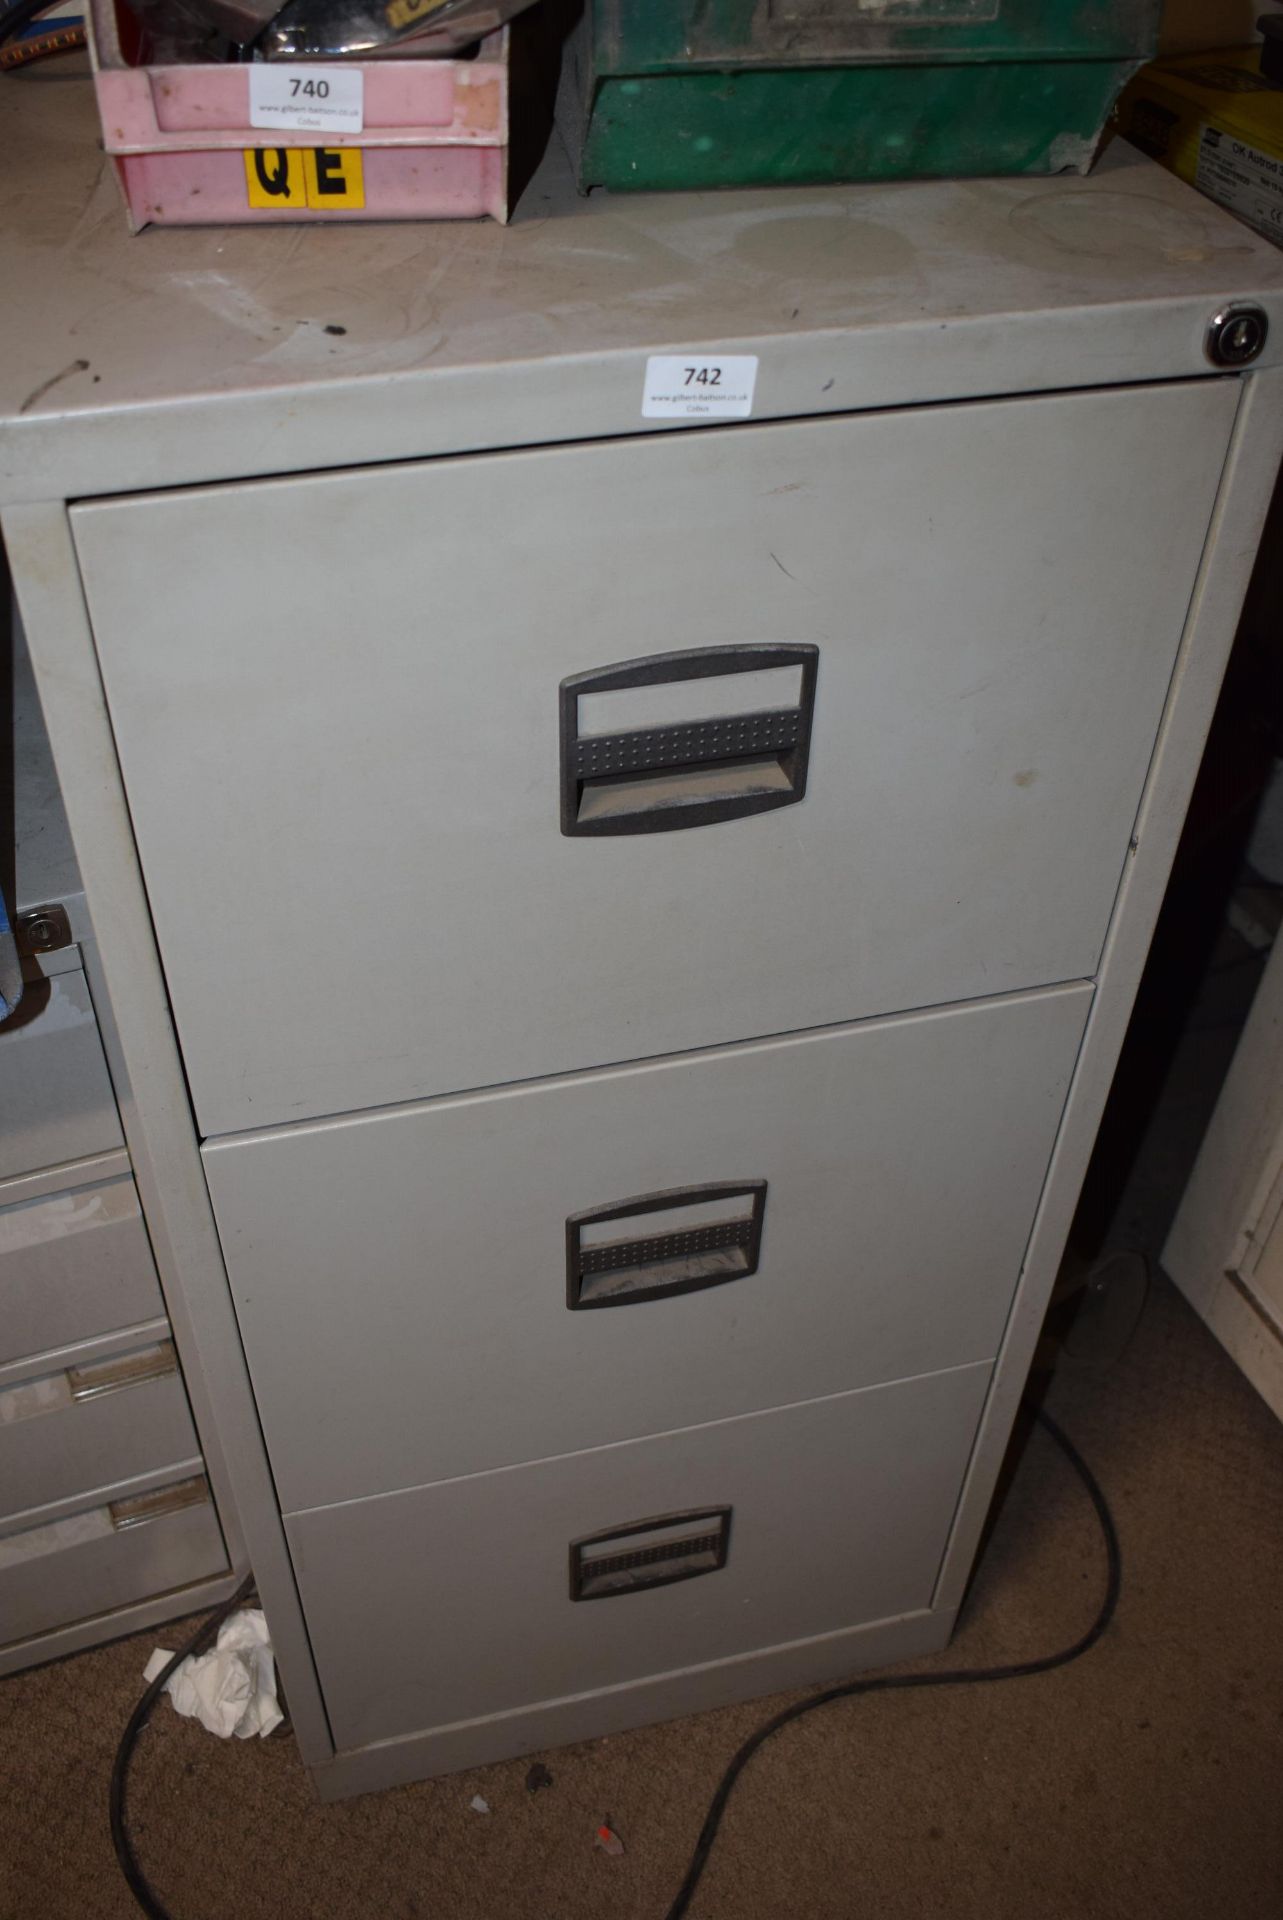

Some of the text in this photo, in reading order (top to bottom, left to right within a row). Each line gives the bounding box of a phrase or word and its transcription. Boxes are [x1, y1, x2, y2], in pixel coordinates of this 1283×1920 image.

[289, 78, 330, 99] 740
[1232, 142, 1246, 157] OK
[684, 367, 722, 386] 742
